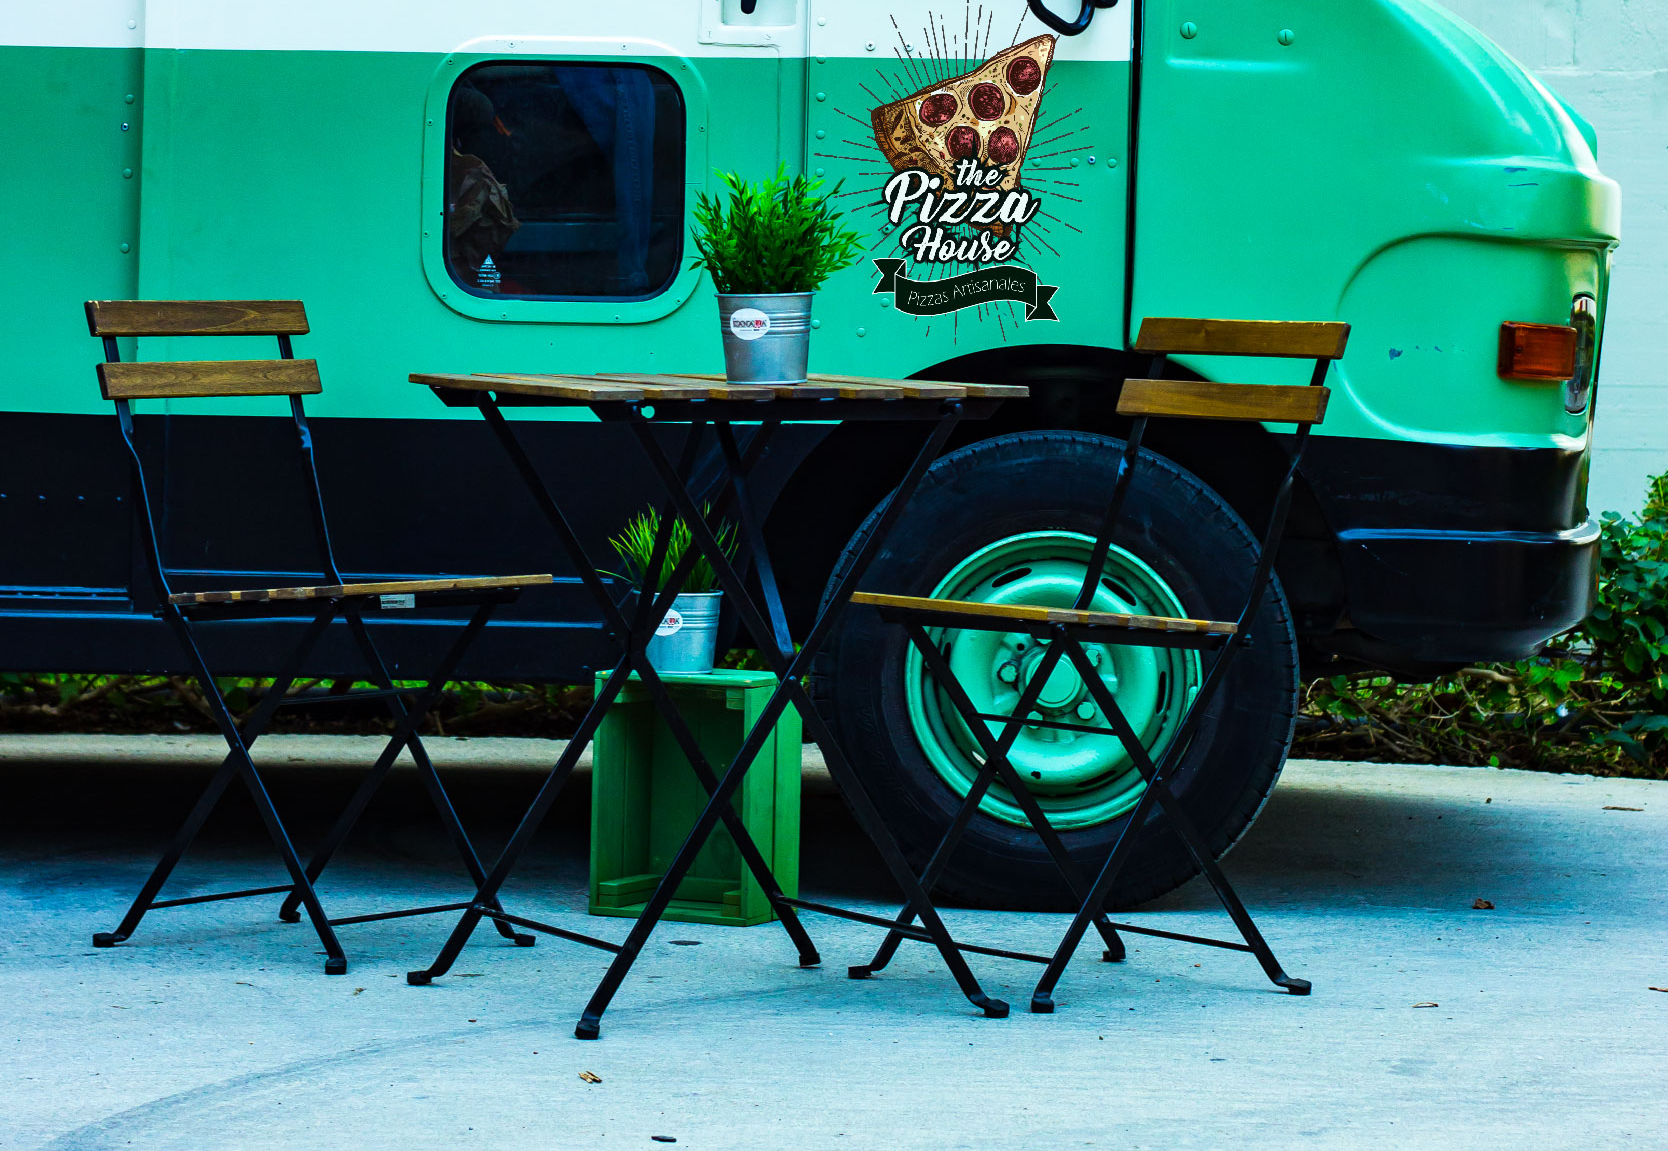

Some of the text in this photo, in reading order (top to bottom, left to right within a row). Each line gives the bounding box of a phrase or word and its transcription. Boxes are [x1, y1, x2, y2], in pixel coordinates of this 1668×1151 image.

[955, 158, 1003, 187] the
[884, 169, 1039, 225] Pizza
[901, 225, 1017, 263] House
[907, 277, 1026, 307] Pizzas Artisanales
